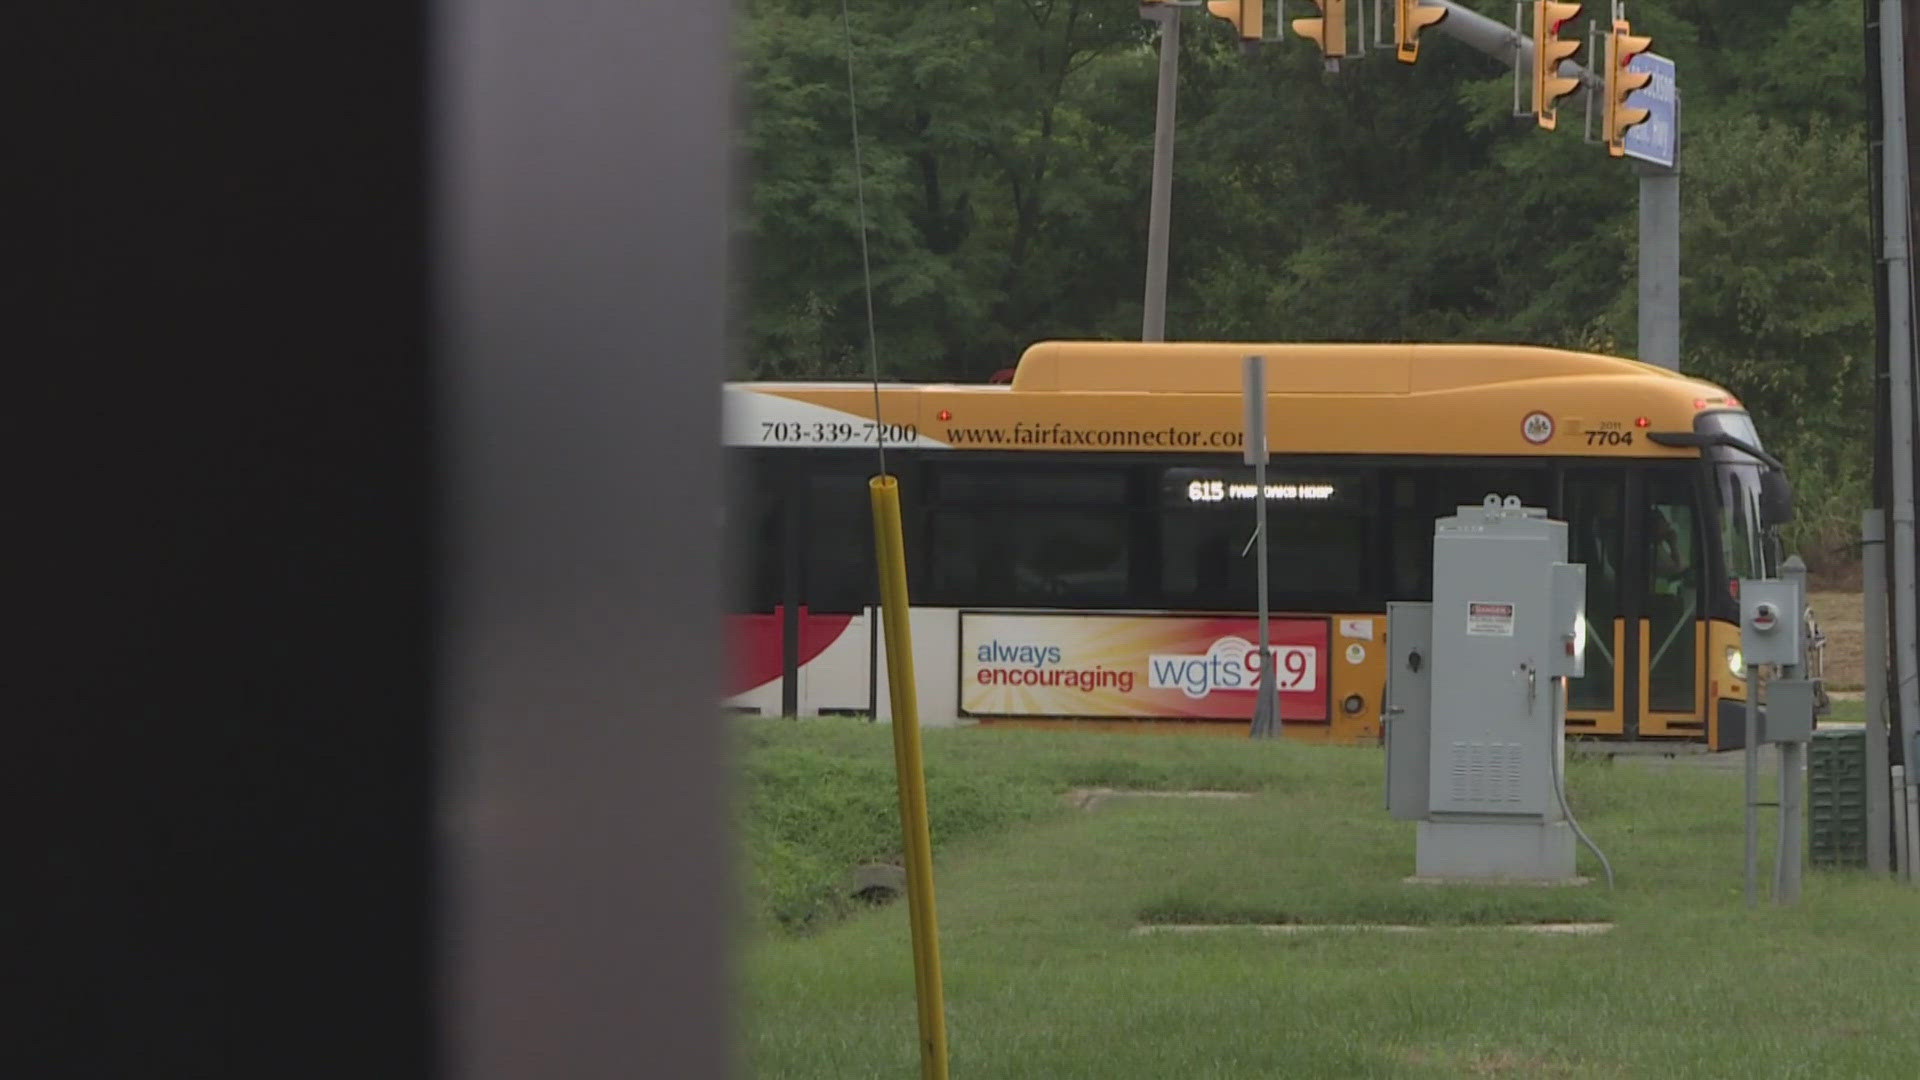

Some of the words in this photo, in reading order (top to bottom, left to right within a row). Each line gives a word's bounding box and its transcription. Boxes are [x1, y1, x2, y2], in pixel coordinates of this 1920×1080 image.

[761, 421, 917, 443] 703-339-7200
[946, 421, 1244, 447] www.fairfaxconnector.co
[1584, 430, 1633, 446] 7704
[1188, 481, 1225, 501] 615
[977, 640, 1062, 668] always
[977, 665, 1134, 693] encouraging
